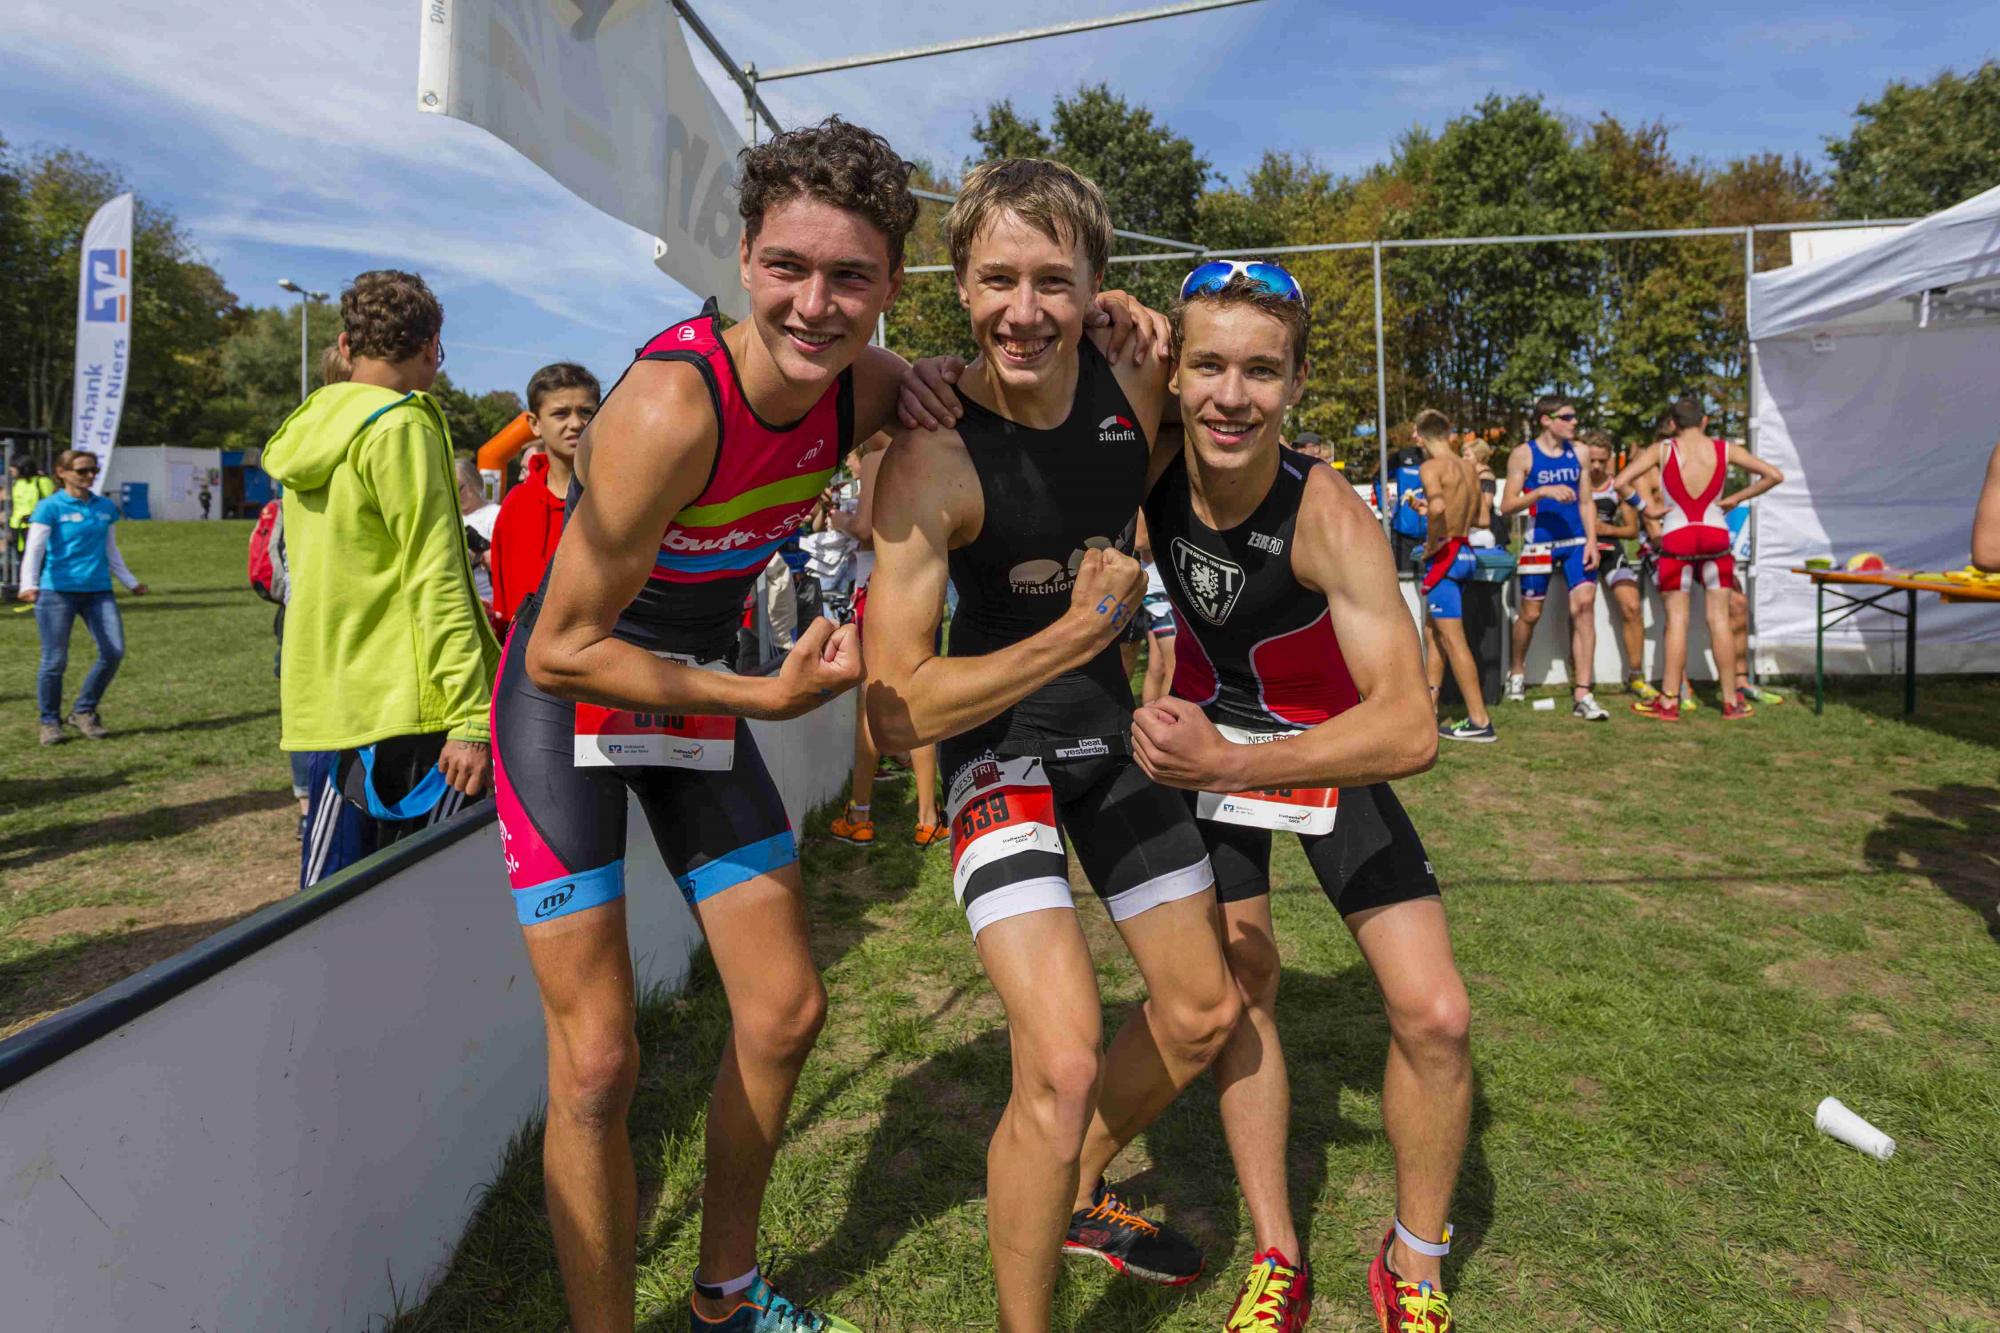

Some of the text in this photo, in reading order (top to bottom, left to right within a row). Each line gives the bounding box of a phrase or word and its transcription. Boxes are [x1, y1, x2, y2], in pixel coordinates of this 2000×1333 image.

[105, 339, 126, 399] Niers
[96, 406, 116, 446] der
[1099, 430, 1136, 441] skinfit
[1081, 739, 1101, 747] beat
[961, 791, 1010, 840] 539
